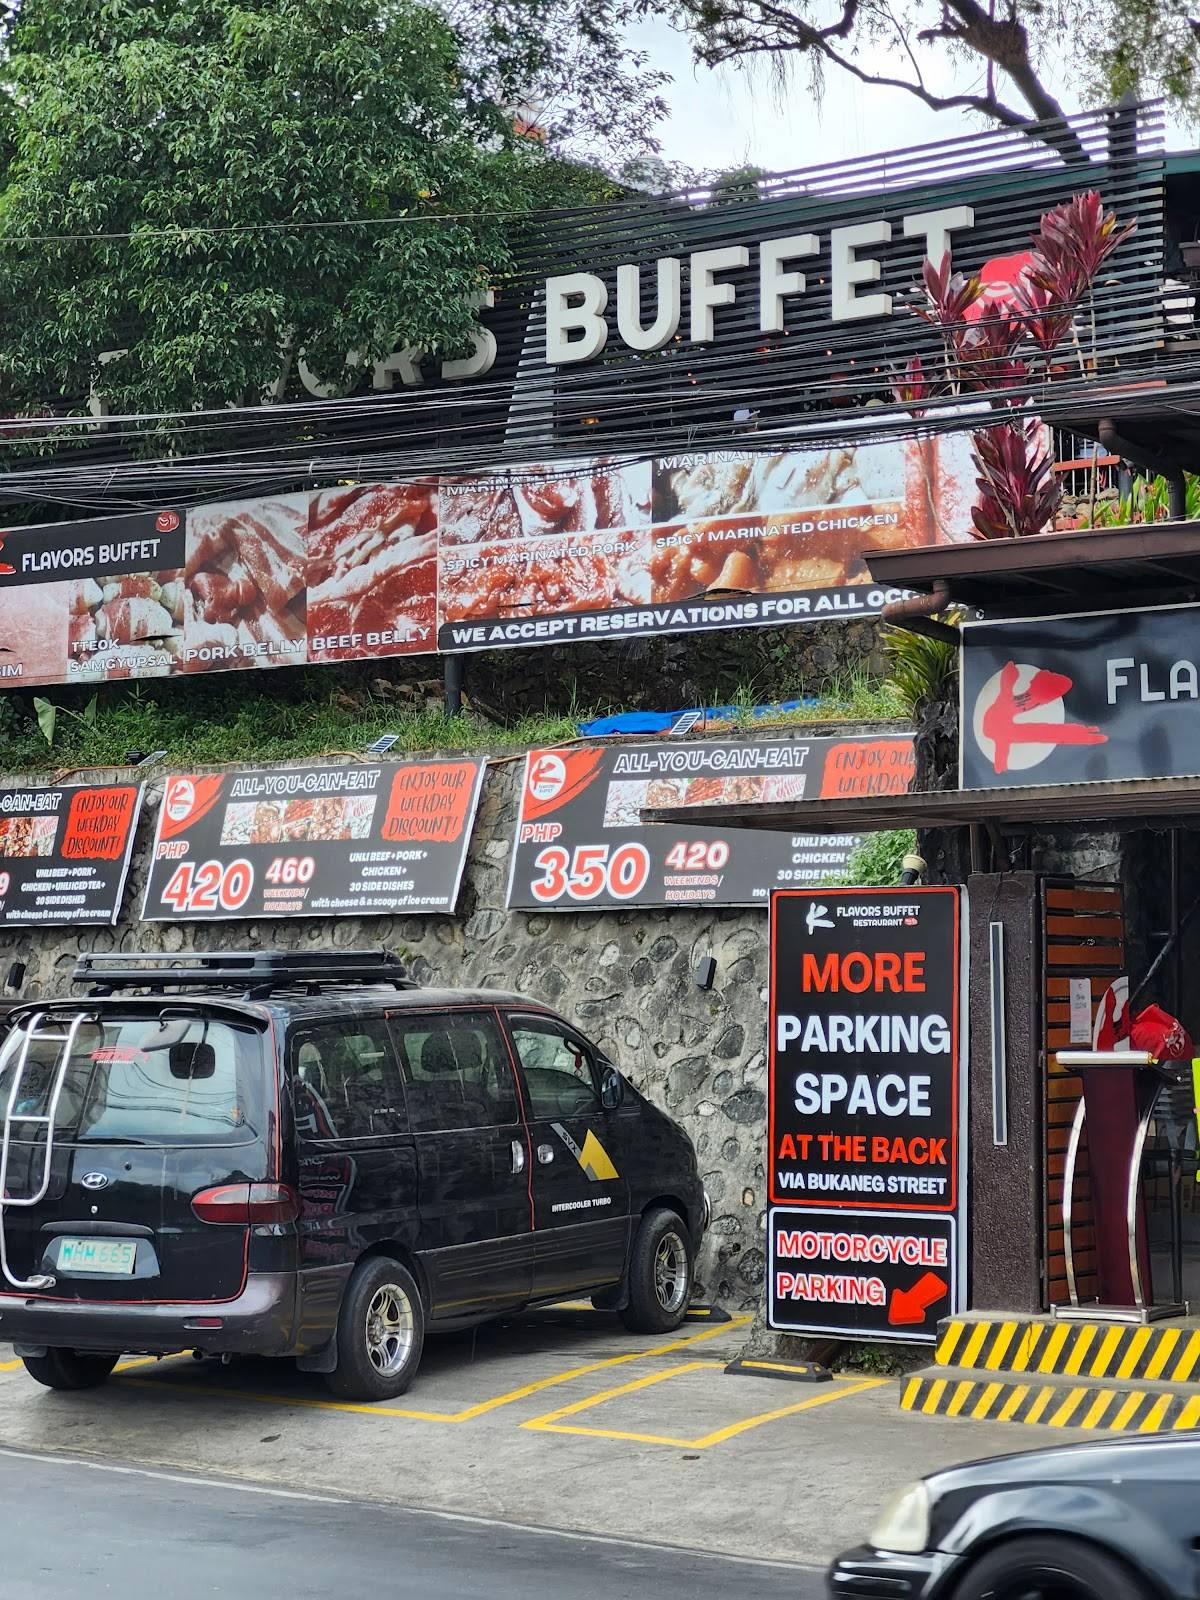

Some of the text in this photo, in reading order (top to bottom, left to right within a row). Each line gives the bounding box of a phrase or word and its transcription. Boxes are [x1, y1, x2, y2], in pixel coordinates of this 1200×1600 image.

[546, 205, 975, 365] BUFFET
[656, 513, 898, 548] SPICY MARINATED CHICKEN
[22, 538, 161, 573] FLAVORS BUFFET
[446, 540, 637, 571] SPICY MARINATED PORK
[452, 627, 486, 644] WE
[489, 618, 577, 637] ACCEPT
[580, 603, 758, 632] RESERVATIONS
[761, 598, 810, 617] FOR
[813, 592, 864, 611] ALL
[72, 638, 119, 653] TTEOK
[312, 627, 430, 651] BEEF BELLY
[185, 639, 305, 662] PORK BELLY
[71, 655, 178, 673] SAMGYUPSAL
[613, 747, 809, 774] ALL-YOU-CAN-EAT
[835, 751, 886, 770] ENJOY
[230, 769, 381, 796] ALL-YOU-CAN-EAT
[400, 769, 466, 791] ENJOY OUR
[838, 773, 911, 794] WEEKDAY
[76, 793, 128, 813] ENJOY OUR
[400, 793, 456, 813] WEEKDAY
[76, 815, 121, 833] WEEKDAY
[389, 816, 458, 836] DISCOUNT!
[519, 822, 562, 843] PHP
[67, 836, 121, 855] DISCOUNT!
[156, 841, 189, 860] PHP
[791, 837, 819, 847] UNLI
[820, 836, 854, 847] PORK
[369, 852, 391, 861] BEEF
[396, 851, 423, 860] PORK
[664, 840, 730, 871] 420
[792, 853, 845, 863] CHICKEN
[265, 856, 315, 884] 460
[361, 866, 402, 876] CHICKEN
[530, 842, 650, 902] 350
[777, 870, 792, 880] 30
[793, 870, 820, 880] SIDE
[161, 859, 254, 912] 420
[349, 880, 415, 892] 30 SIDE DISHES
[665, 889, 716, 900] HOLIDAYS
[837, 905, 920, 917] FLAVORS BUFFET
[802, 951, 926, 993] MORE
[777, 1014, 951, 1054] PARKING
[794, 1072, 932, 1117] SPACE
[778, 1133, 947, 1165] AT THE BACK
[778, 1171, 947, 1195] VIA BUKANEG STREET
[552, 1196, 611, 1213] INTERCOOLER TURBO
[777, 1230, 948, 1267] MOTORCYCLE
[777, 1272, 887, 1306] PARKING
